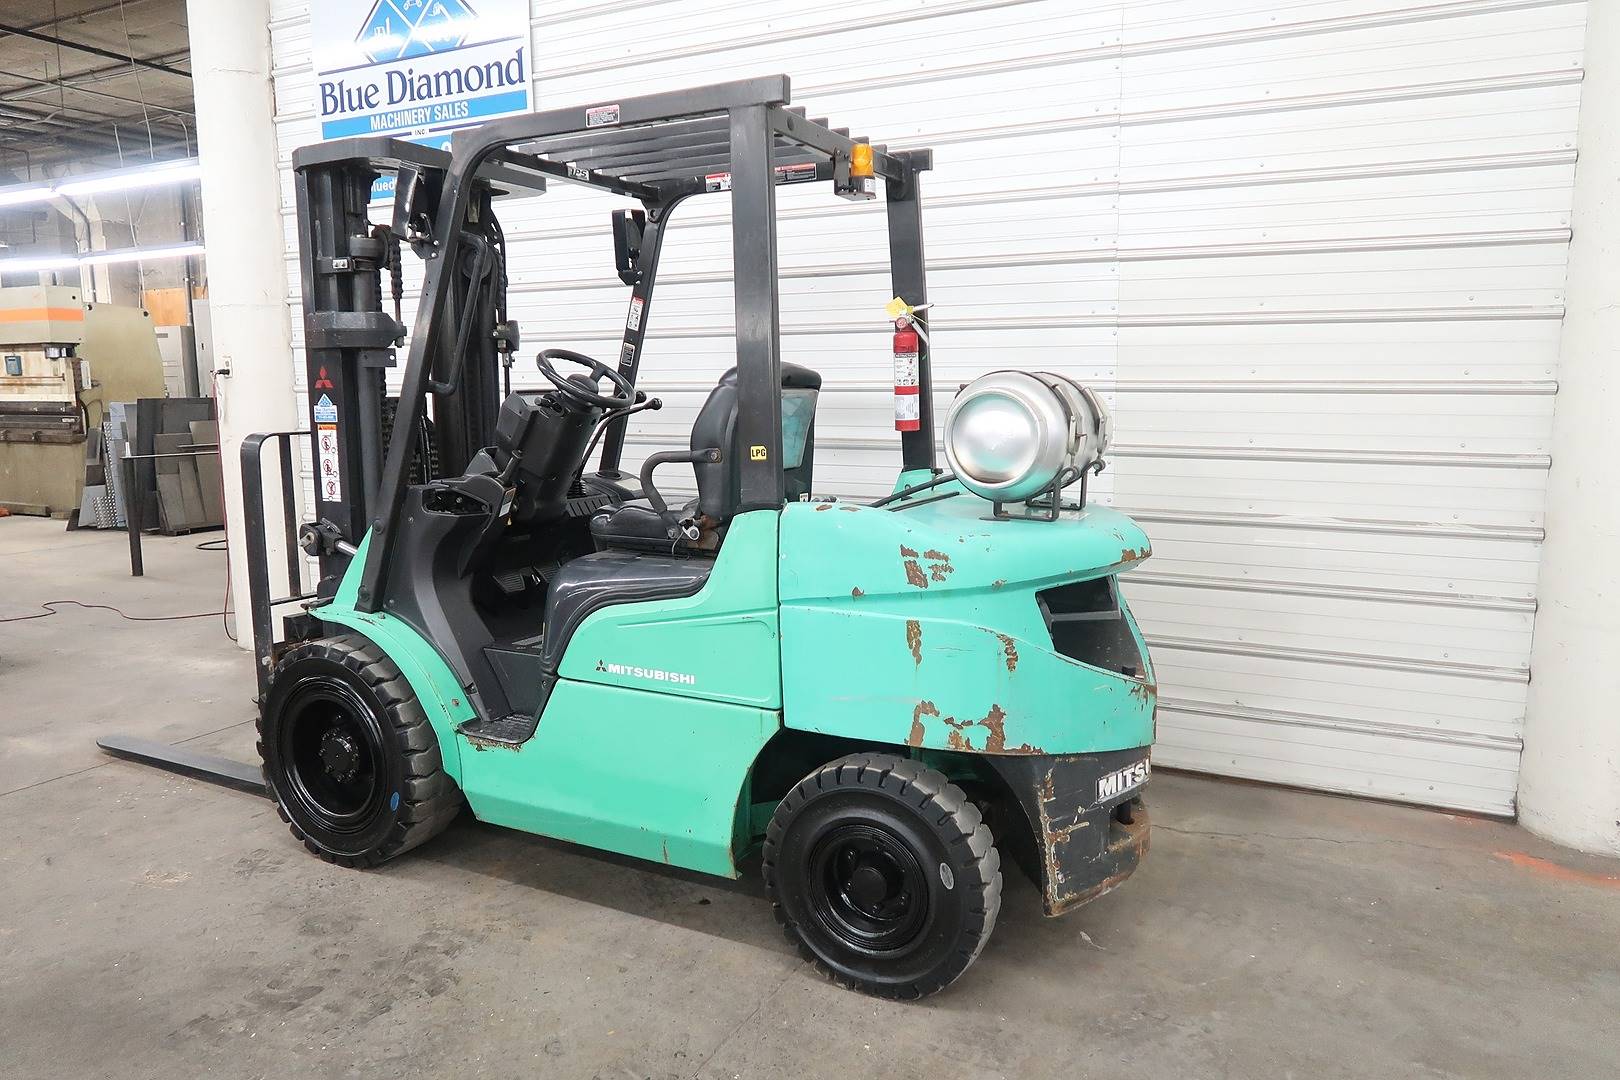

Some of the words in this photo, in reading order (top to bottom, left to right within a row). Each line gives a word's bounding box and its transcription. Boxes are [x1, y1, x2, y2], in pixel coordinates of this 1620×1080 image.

[320, 80, 380, 116] Blue
[385, 46, 526, 105] Diamond
[370, 105, 432, 132] MACHINERY
[434, 101, 469, 121] SALES
[751, 448, 766, 457] LPG
[608, 663, 695, 685] MITSUBISHI
